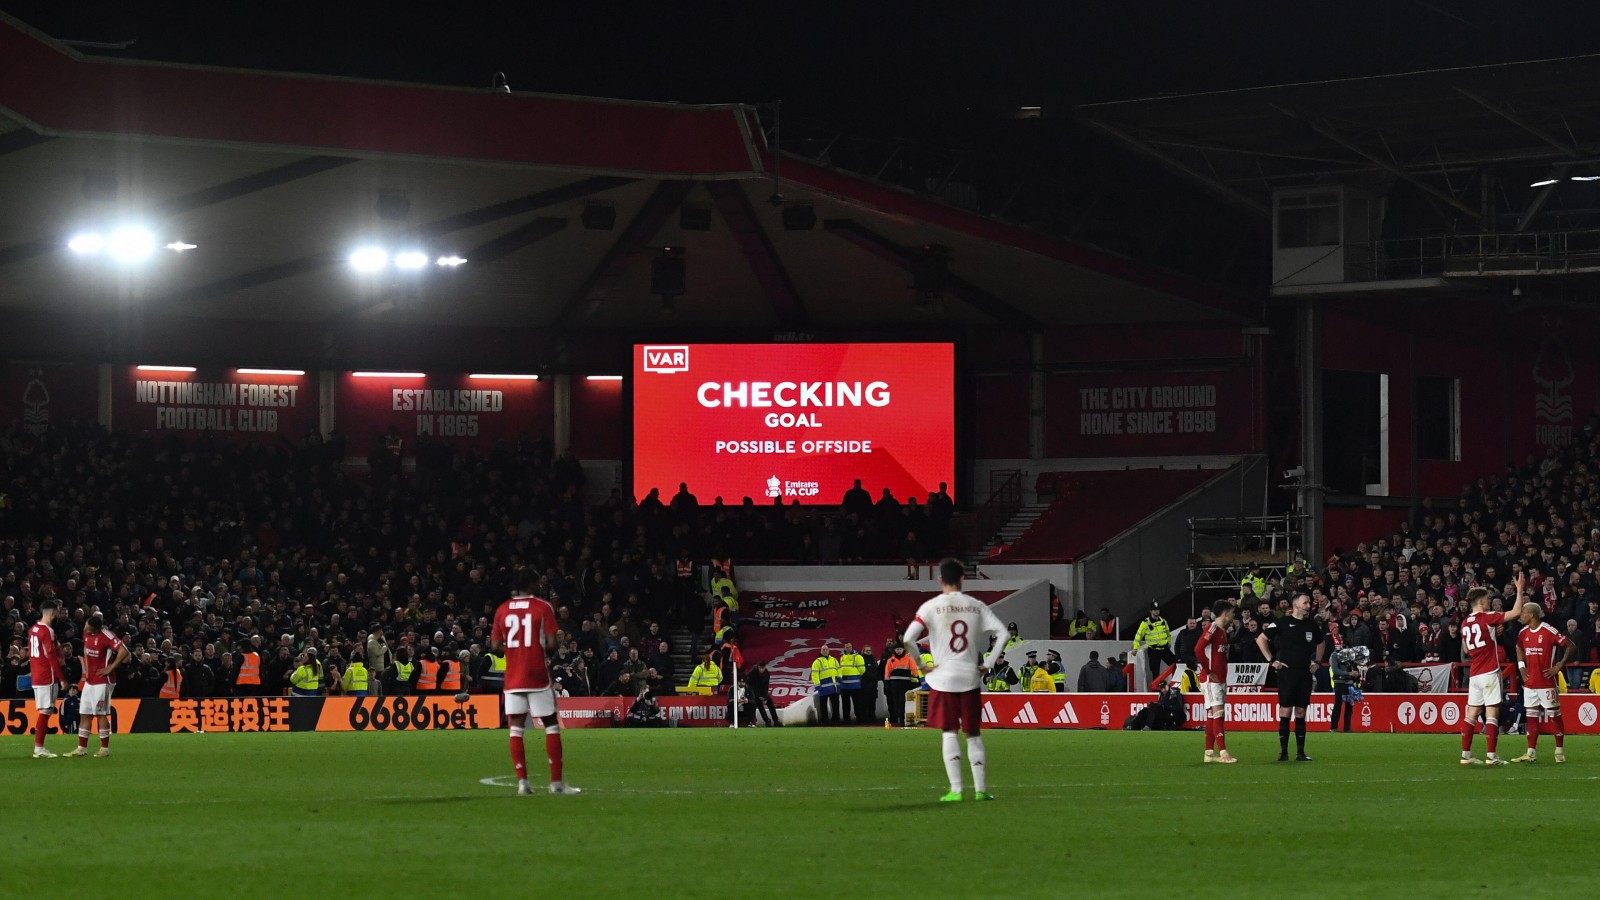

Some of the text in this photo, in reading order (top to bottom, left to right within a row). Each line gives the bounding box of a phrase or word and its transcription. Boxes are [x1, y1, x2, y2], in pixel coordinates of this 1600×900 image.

[648, 352, 685, 366] VAR
[136, 380, 299, 408] NOTTINGHAM FOREST
[392, 388, 503, 412] ESTABLISHED
[697, 381, 891, 408] CHECKING
[1079, 385, 1217, 410] THE CITY GROUND
[156, 406, 278, 432] FOOTBALL CLUB
[416, 414, 479, 437] IN 1865
[764, 412, 822, 428] GOAL
[1080, 410, 1216, 435] HOME SINCE 1898
[715, 440, 872, 454] POSSIBLE OFFSIDE
[785, 480, 819, 489] Emirates
[785, 488, 819, 496] FA CUP
[505, 613, 532, 649] 21
[759, 620, 801, 628] REDS
[30, 635, 40, 658] 18
[949, 620, 968, 654] 8
[1462, 623, 1487, 650] 22
[1234, 664, 1262, 674] NORMO
[1236, 675, 1255, 684] REDS
[169, 698, 290, 732] 英超投注
[349, 696, 478, 731] 6686bet
[685, 705, 707, 720] YOU
[709, 705, 728, 720] RED
[1234, 703, 1274, 722] SOCIAL
